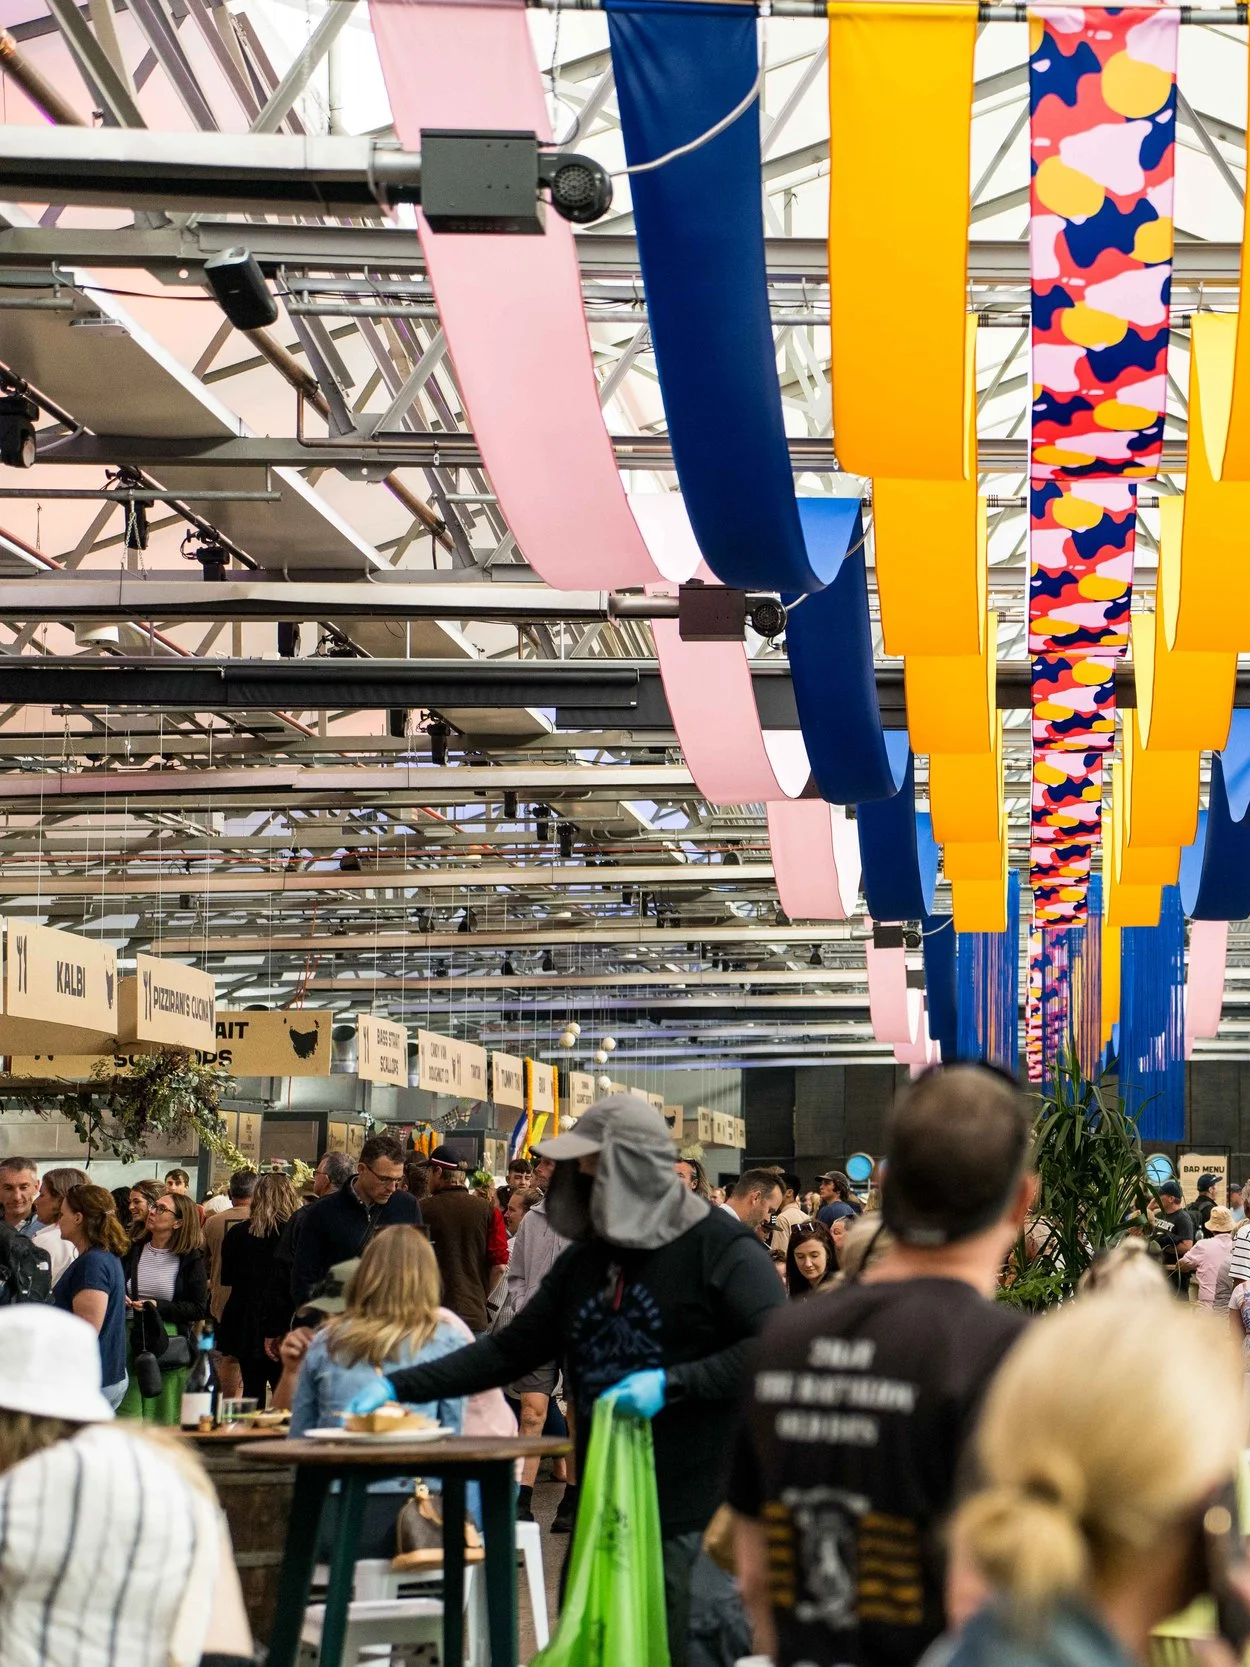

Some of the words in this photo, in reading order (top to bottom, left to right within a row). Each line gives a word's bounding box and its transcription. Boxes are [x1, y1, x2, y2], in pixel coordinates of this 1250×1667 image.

[56, 960, 86, 998] KALBI
[153, 985, 190, 1017] PIZZIRANI'S
[216, 1021, 249, 1040] AIT
[1183, 1165, 1201, 1173] BAR
[1202, 1165, 1225, 1174] MENU
